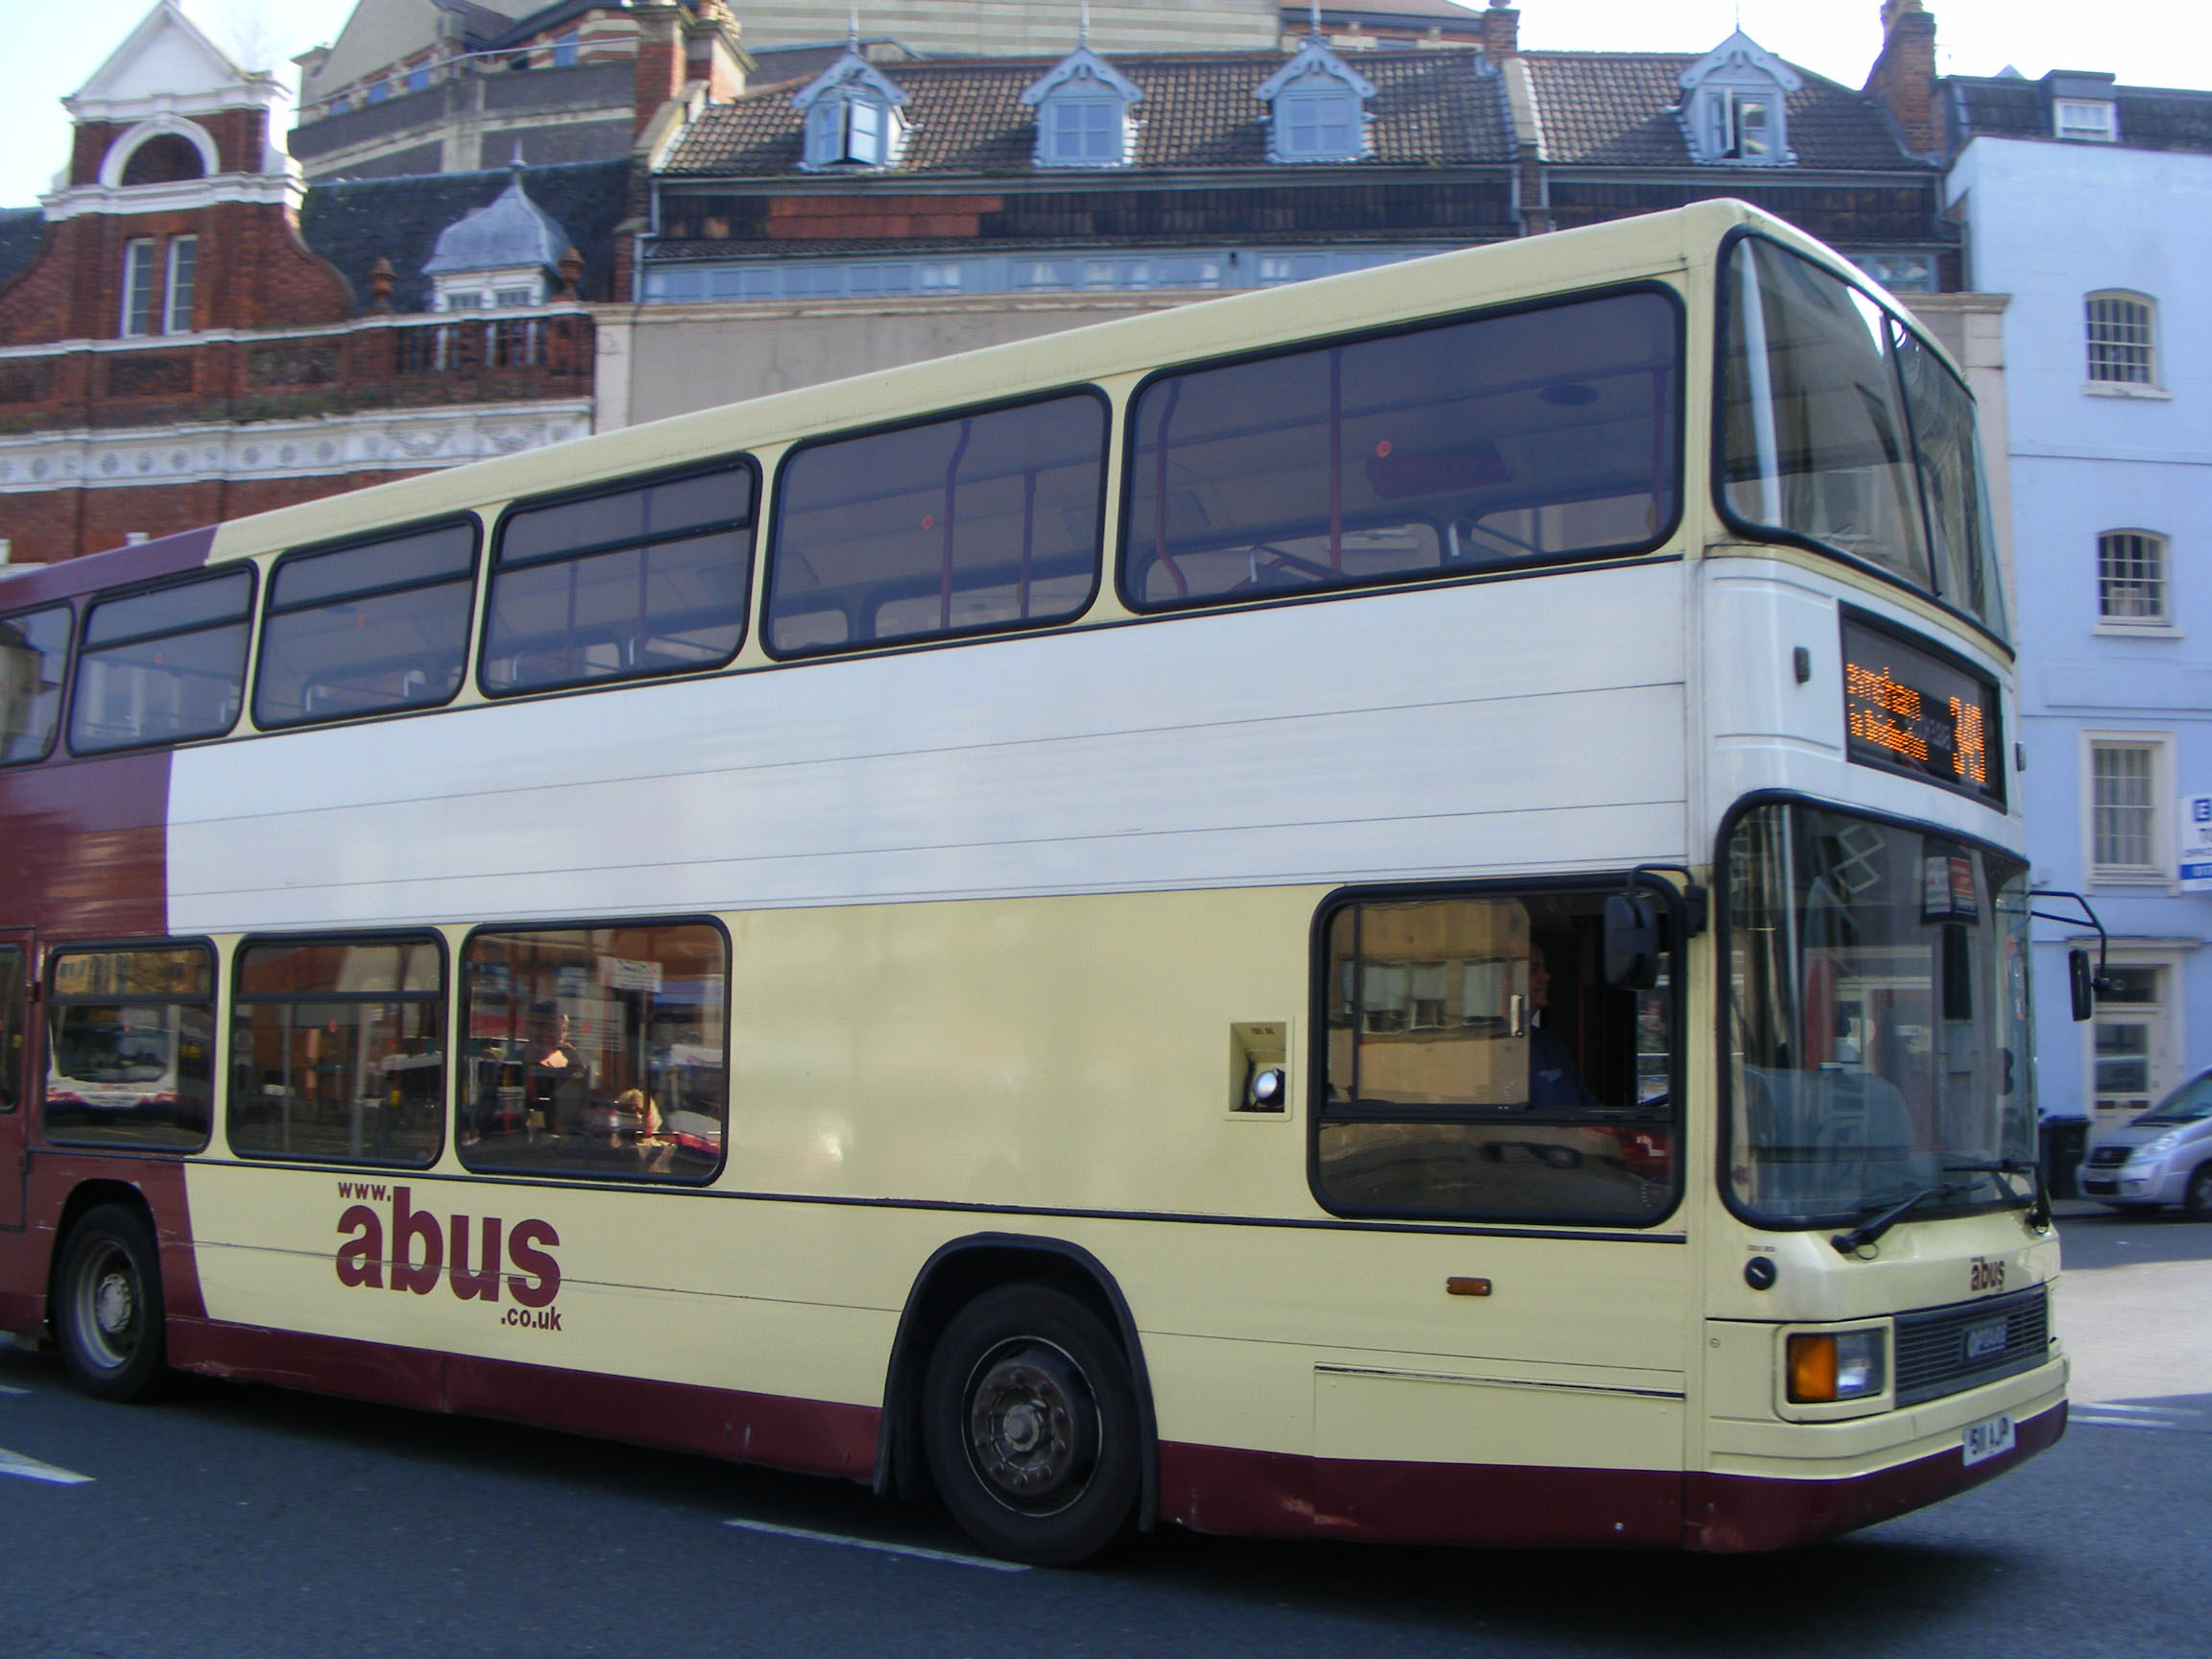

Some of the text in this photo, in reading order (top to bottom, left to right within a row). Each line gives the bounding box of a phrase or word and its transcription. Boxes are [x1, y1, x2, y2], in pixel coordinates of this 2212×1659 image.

[338, 1182, 392, 1202] www.
[336, 1186, 562, 1309] abus
[1970, 1258, 2006, 1292] abus
[500, 1307, 563, 1332] .co.uk
